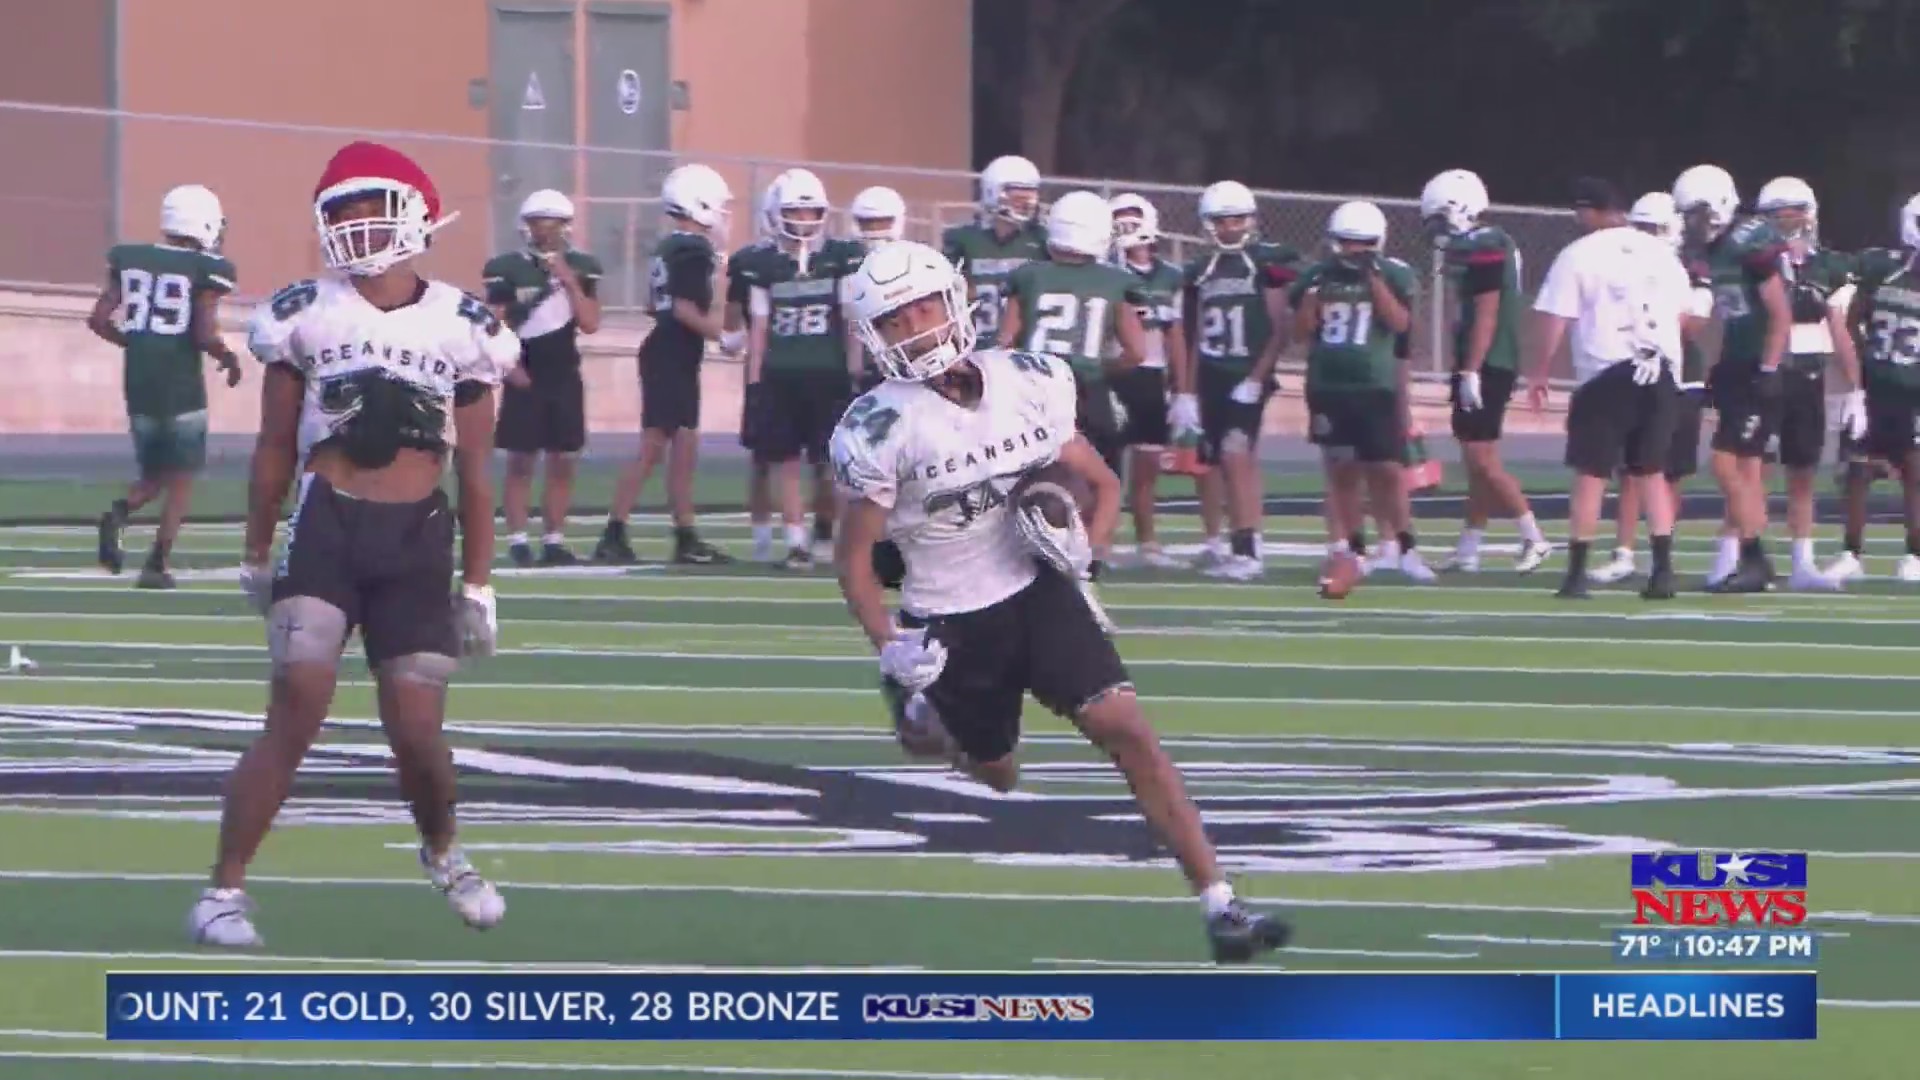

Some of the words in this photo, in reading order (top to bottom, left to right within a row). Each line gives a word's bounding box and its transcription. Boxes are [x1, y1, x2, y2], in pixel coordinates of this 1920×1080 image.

[119, 268, 192, 335] 89
[773, 304, 832, 336] 88
[1030, 293, 1108, 358] 21
[1321, 302, 1372, 345] 81
[1201, 306, 1250, 357] 21
[1872, 310, 1920, 364] 33
